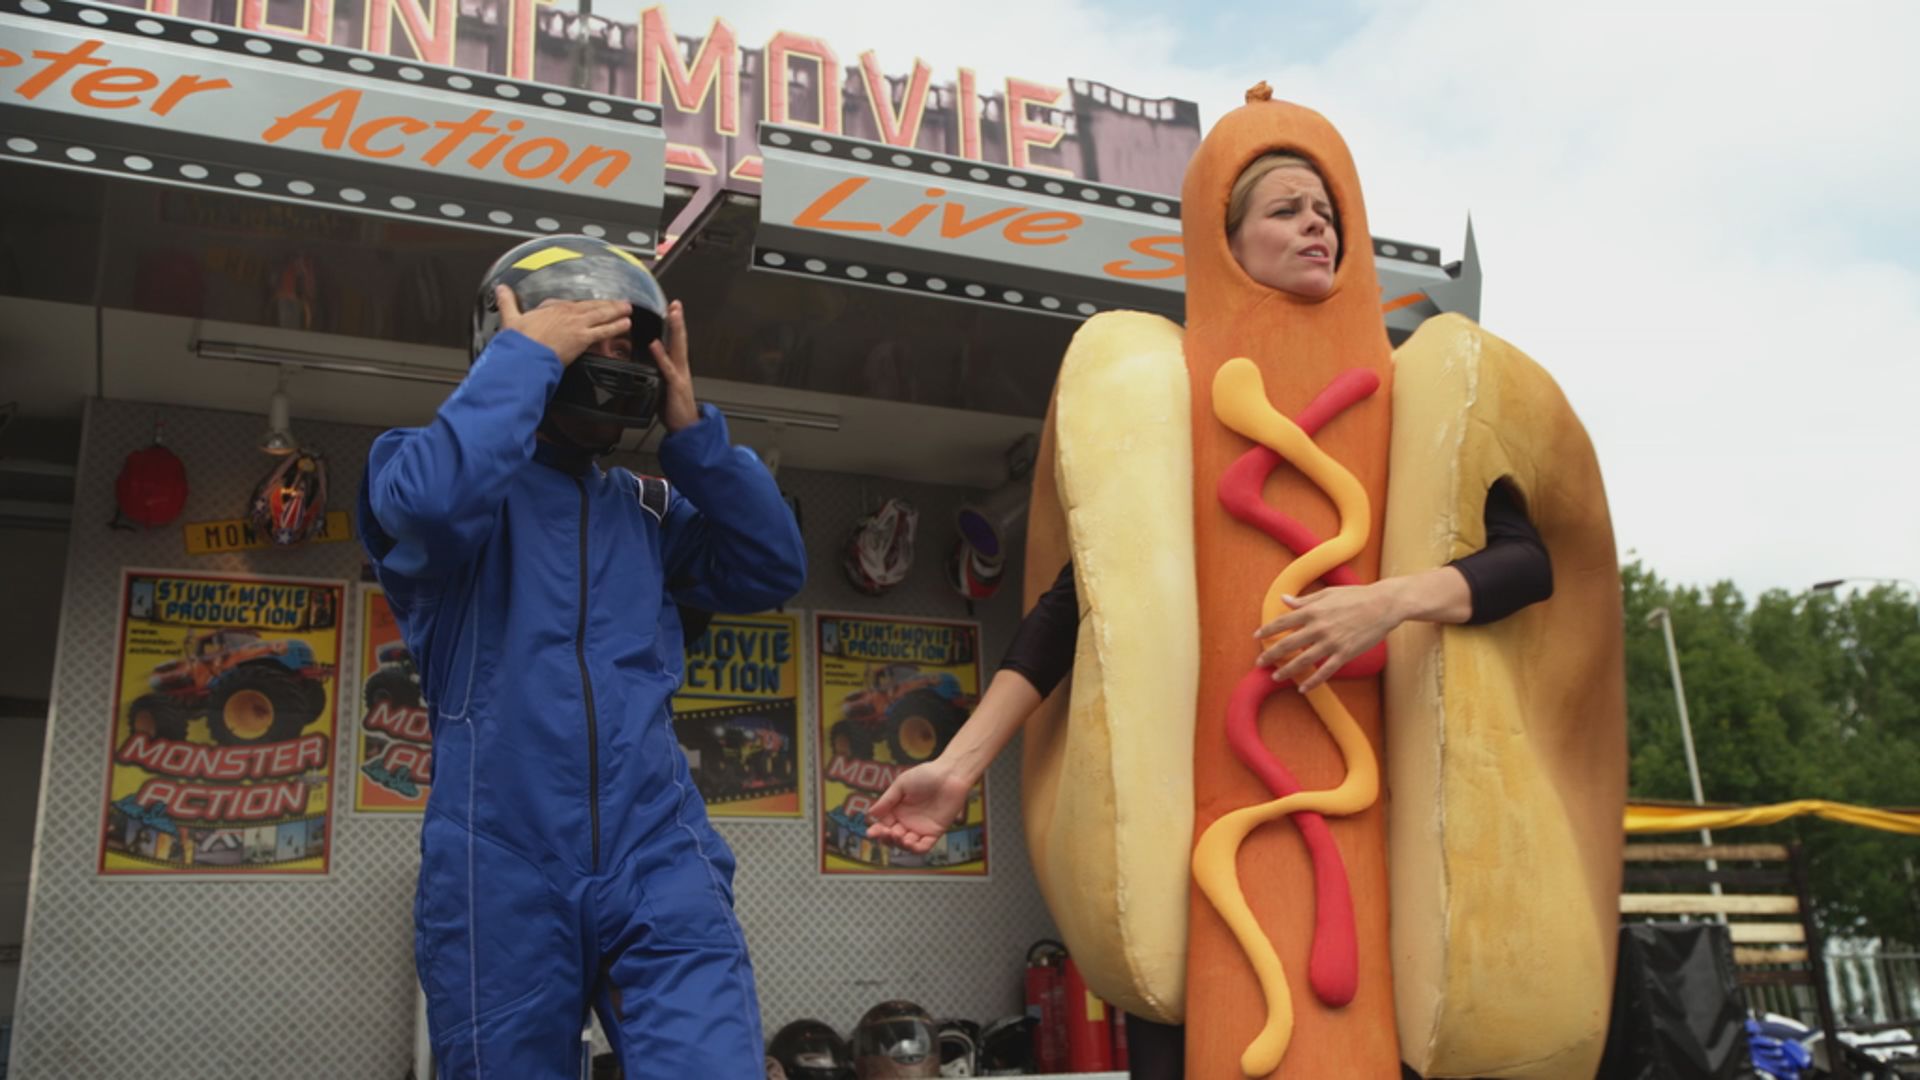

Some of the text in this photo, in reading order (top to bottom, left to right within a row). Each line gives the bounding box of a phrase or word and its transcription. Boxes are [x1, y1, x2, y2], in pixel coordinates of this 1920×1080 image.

[637, 5, 1075, 178] MOVIE
[0, 40, 233, 117] ter
[261, 88, 632, 189] Action
[793, 176, 1083, 246] Live
[166, 601, 299, 626] PRODUCTION
[849, 640, 946, 660] PRODUCTION
[687, 659, 781, 694] CTION
[122, 735, 323, 776] MONSTER
[137, 780, 304, 816] ACTION
